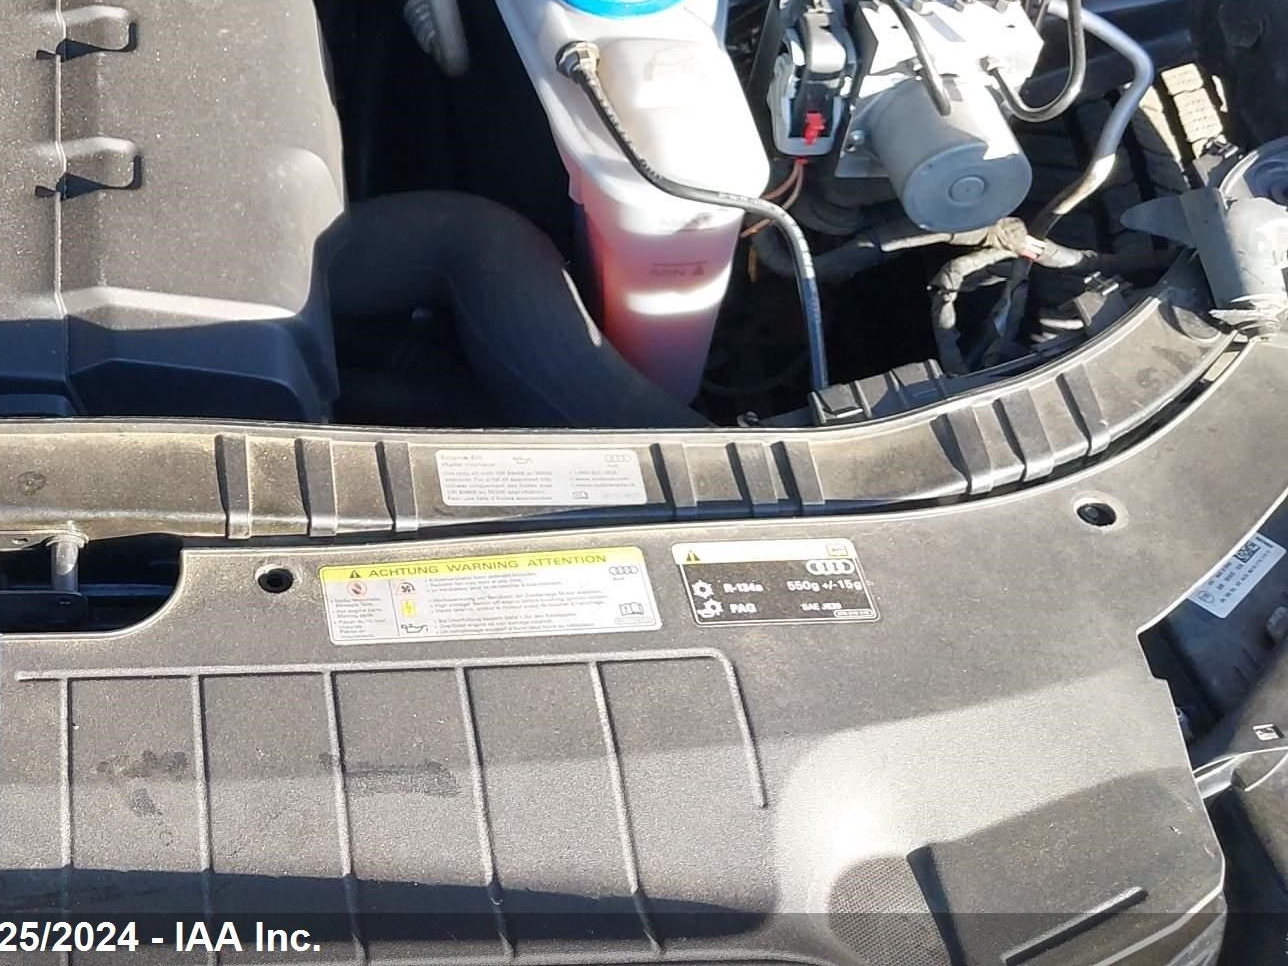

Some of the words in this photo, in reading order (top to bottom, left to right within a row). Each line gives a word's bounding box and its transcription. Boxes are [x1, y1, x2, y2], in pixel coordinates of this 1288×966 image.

[369, 564, 439, 578] ACHTUNG
[447, 560, 520, 572] WARNING
[527, 554, 607, 567] ATTENTION
[729, 603, 758, 613] PAG
